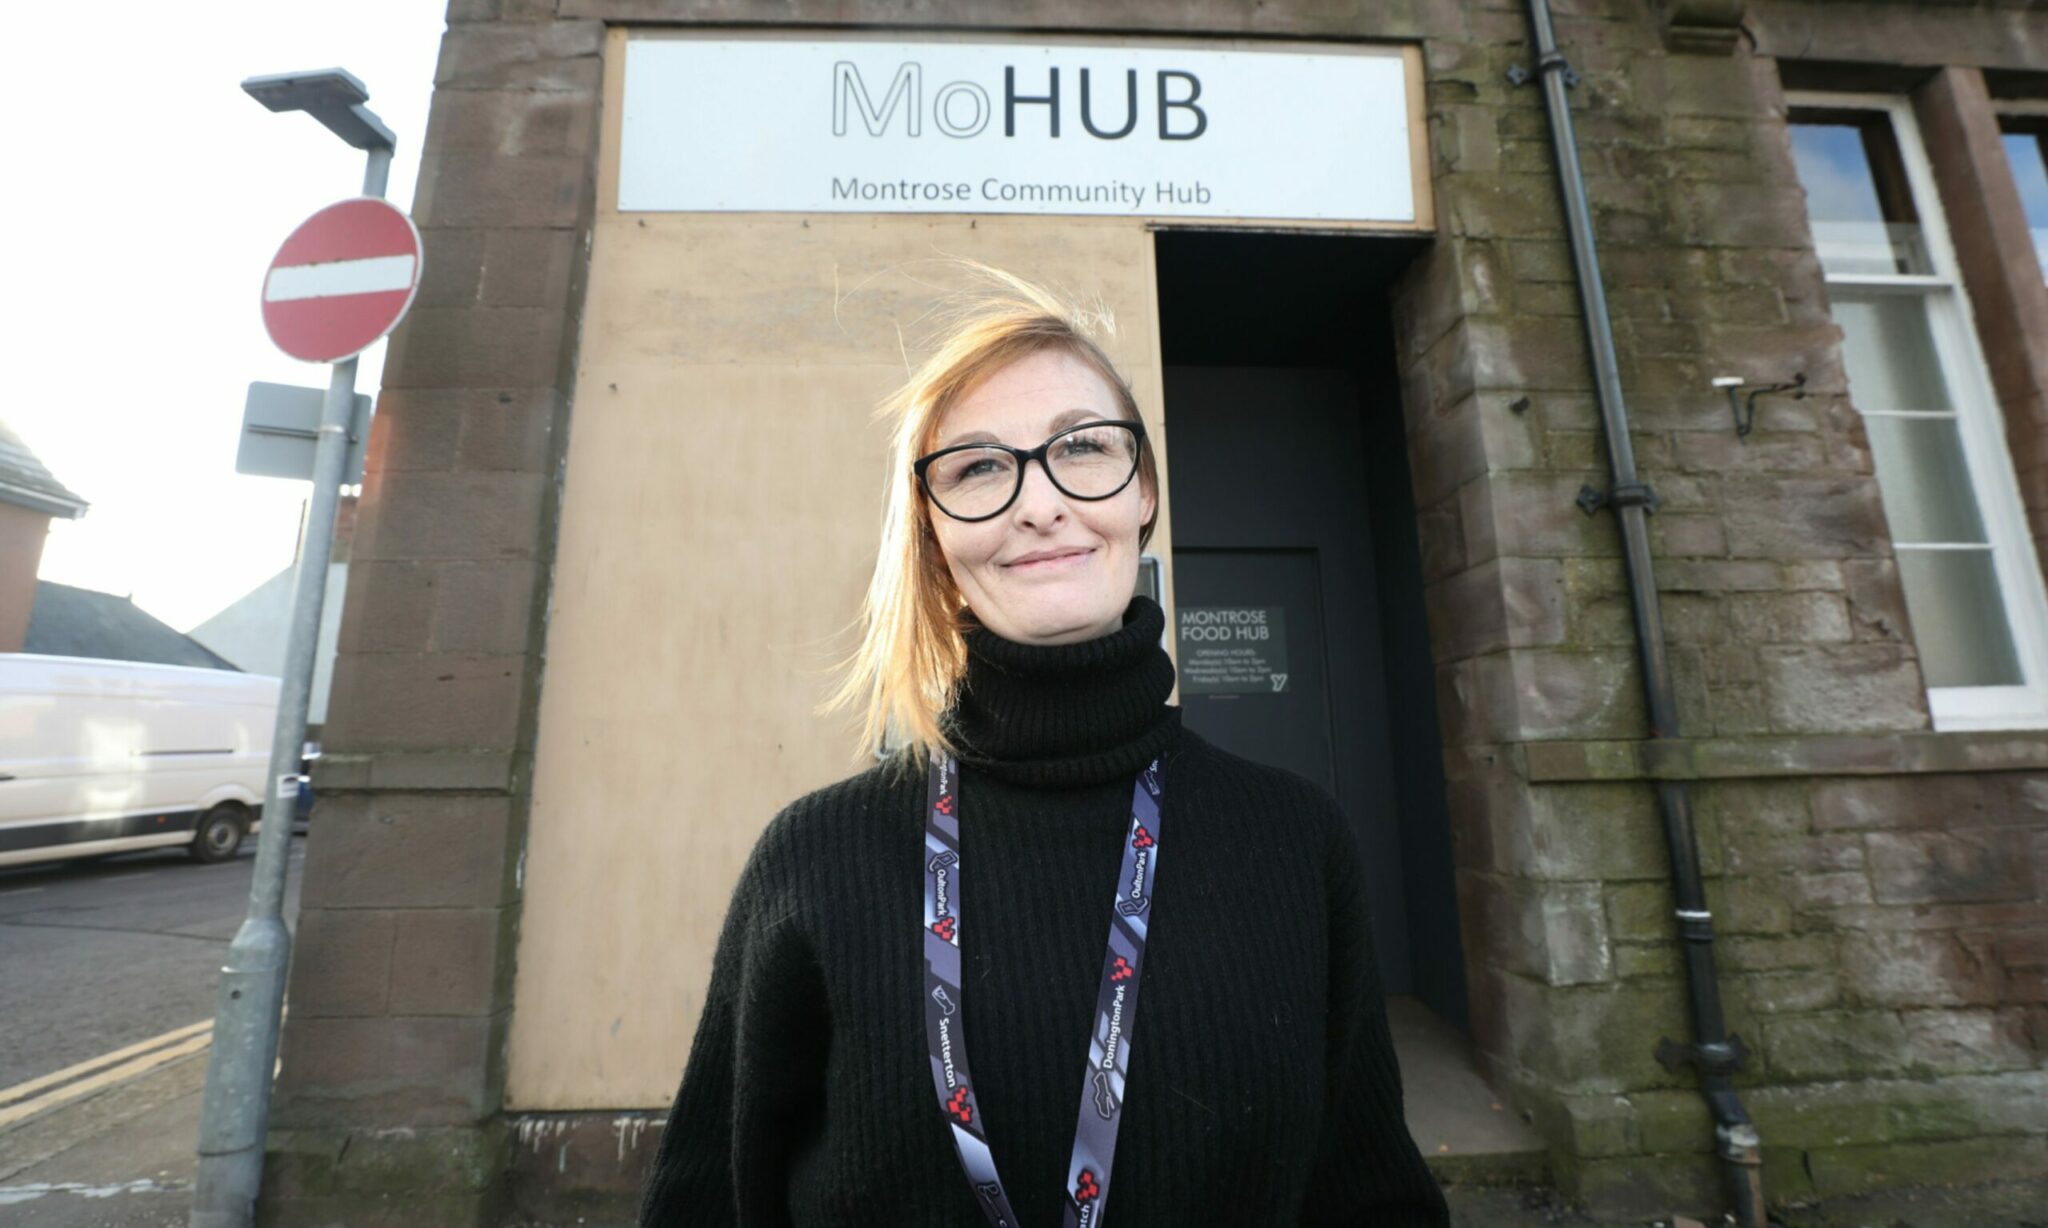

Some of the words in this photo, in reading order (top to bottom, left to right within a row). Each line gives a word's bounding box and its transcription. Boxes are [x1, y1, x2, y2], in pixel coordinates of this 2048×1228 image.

[832, 60, 1209, 142] MoHUB
[831, 176, 972, 201] Montrose
[981, 177, 1146, 208] Community
[1156, 180, 1212, 205] Hub
[1181, 610, 1267, 625] MONTROSE
[1181, 626, 1232, 641] FOOD
[1235, 625, 1270, 640] HUB
[937, 868, 947, 917] OultonPark
[1132, 850, 1147, 899] OultonPark
[1102, 984, 1126, 1070] DoningtonPark
[938, 1017, 956, 1089] Snetterton
